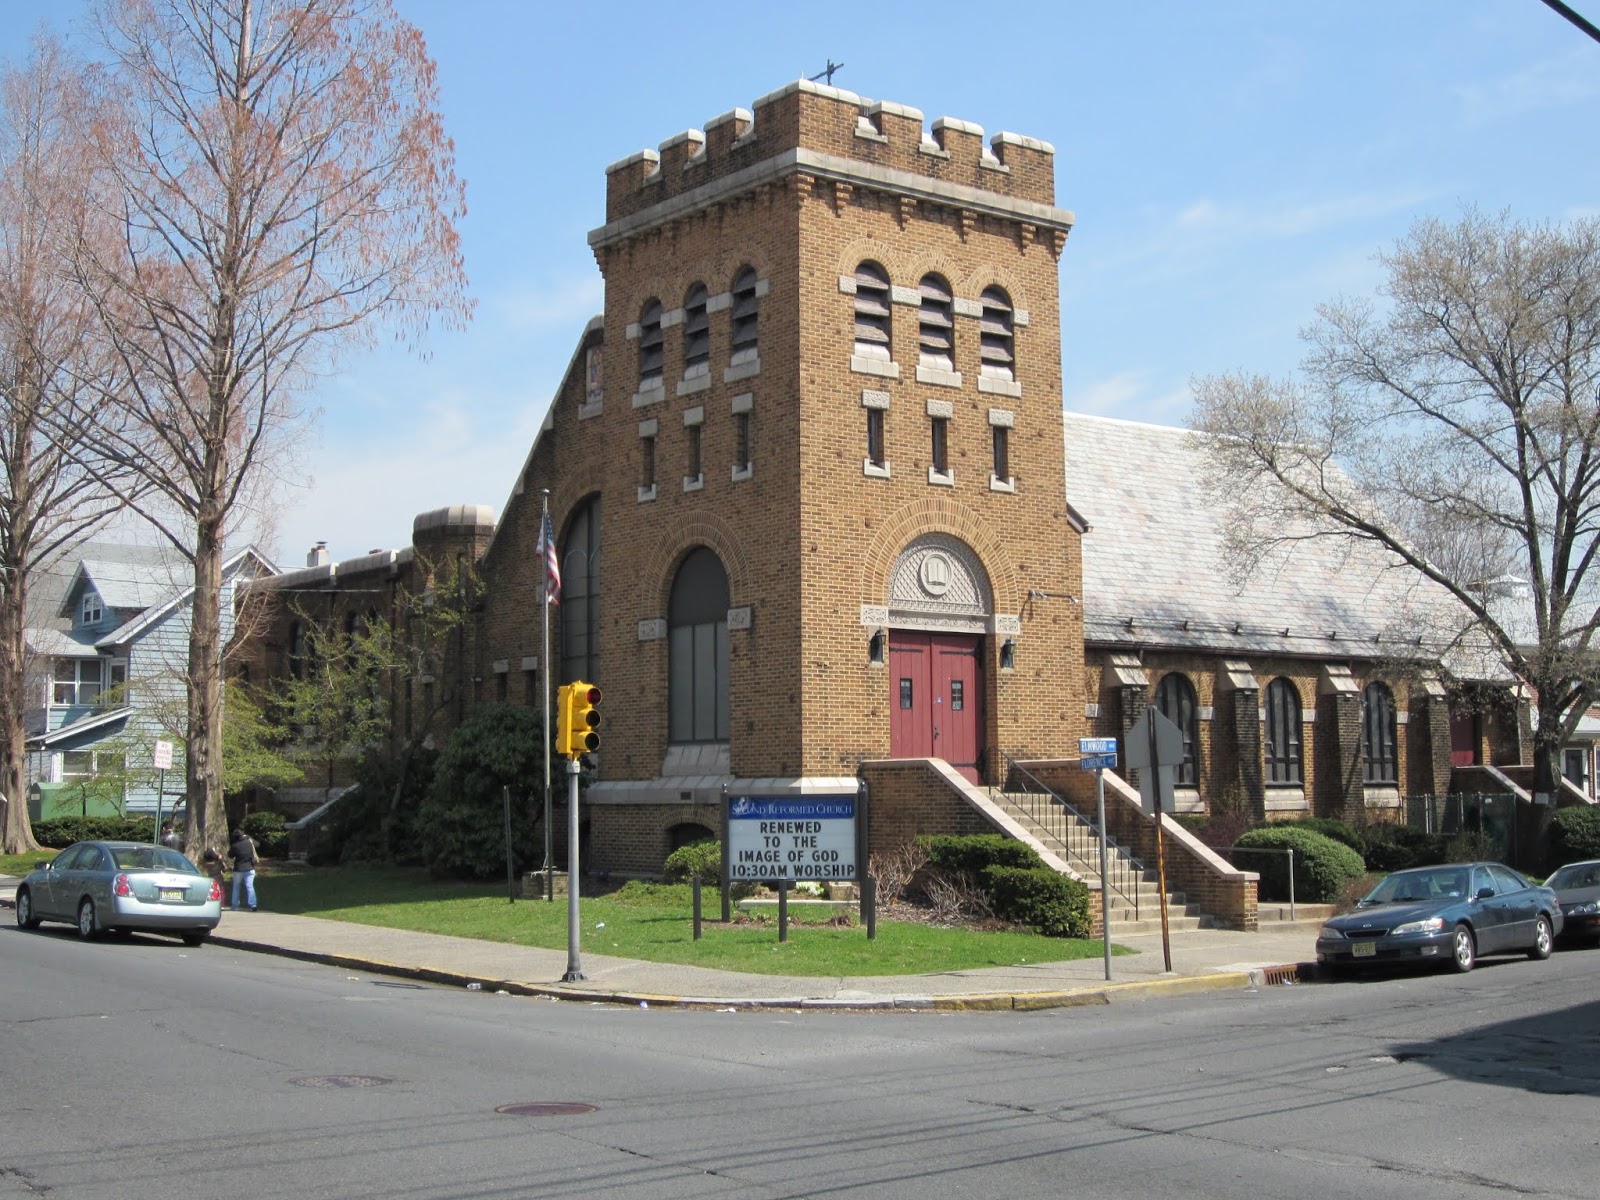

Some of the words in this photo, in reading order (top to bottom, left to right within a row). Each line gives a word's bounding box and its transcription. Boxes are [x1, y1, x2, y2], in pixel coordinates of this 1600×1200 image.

[1081, 741, 1107, 751] ELMWOOD
[1081, 757, 1107, 769] FLORENCE
[768, 804, 815, 814] REFORMED
[816, 804, 852, 814] CHURCH
[760, 821, 822, 833] RENEWED
[763, 836, 781, 848] TO
[792, 836, 818, 848] THE
[739, 850, 780, 862] IMAGE
[788, 850, 804, 862] OF
[812, 850, 839, 862] GOD
[732, 864, 787, 877] 10:30AM
[794, 864, 855, 876] WORSHIP
